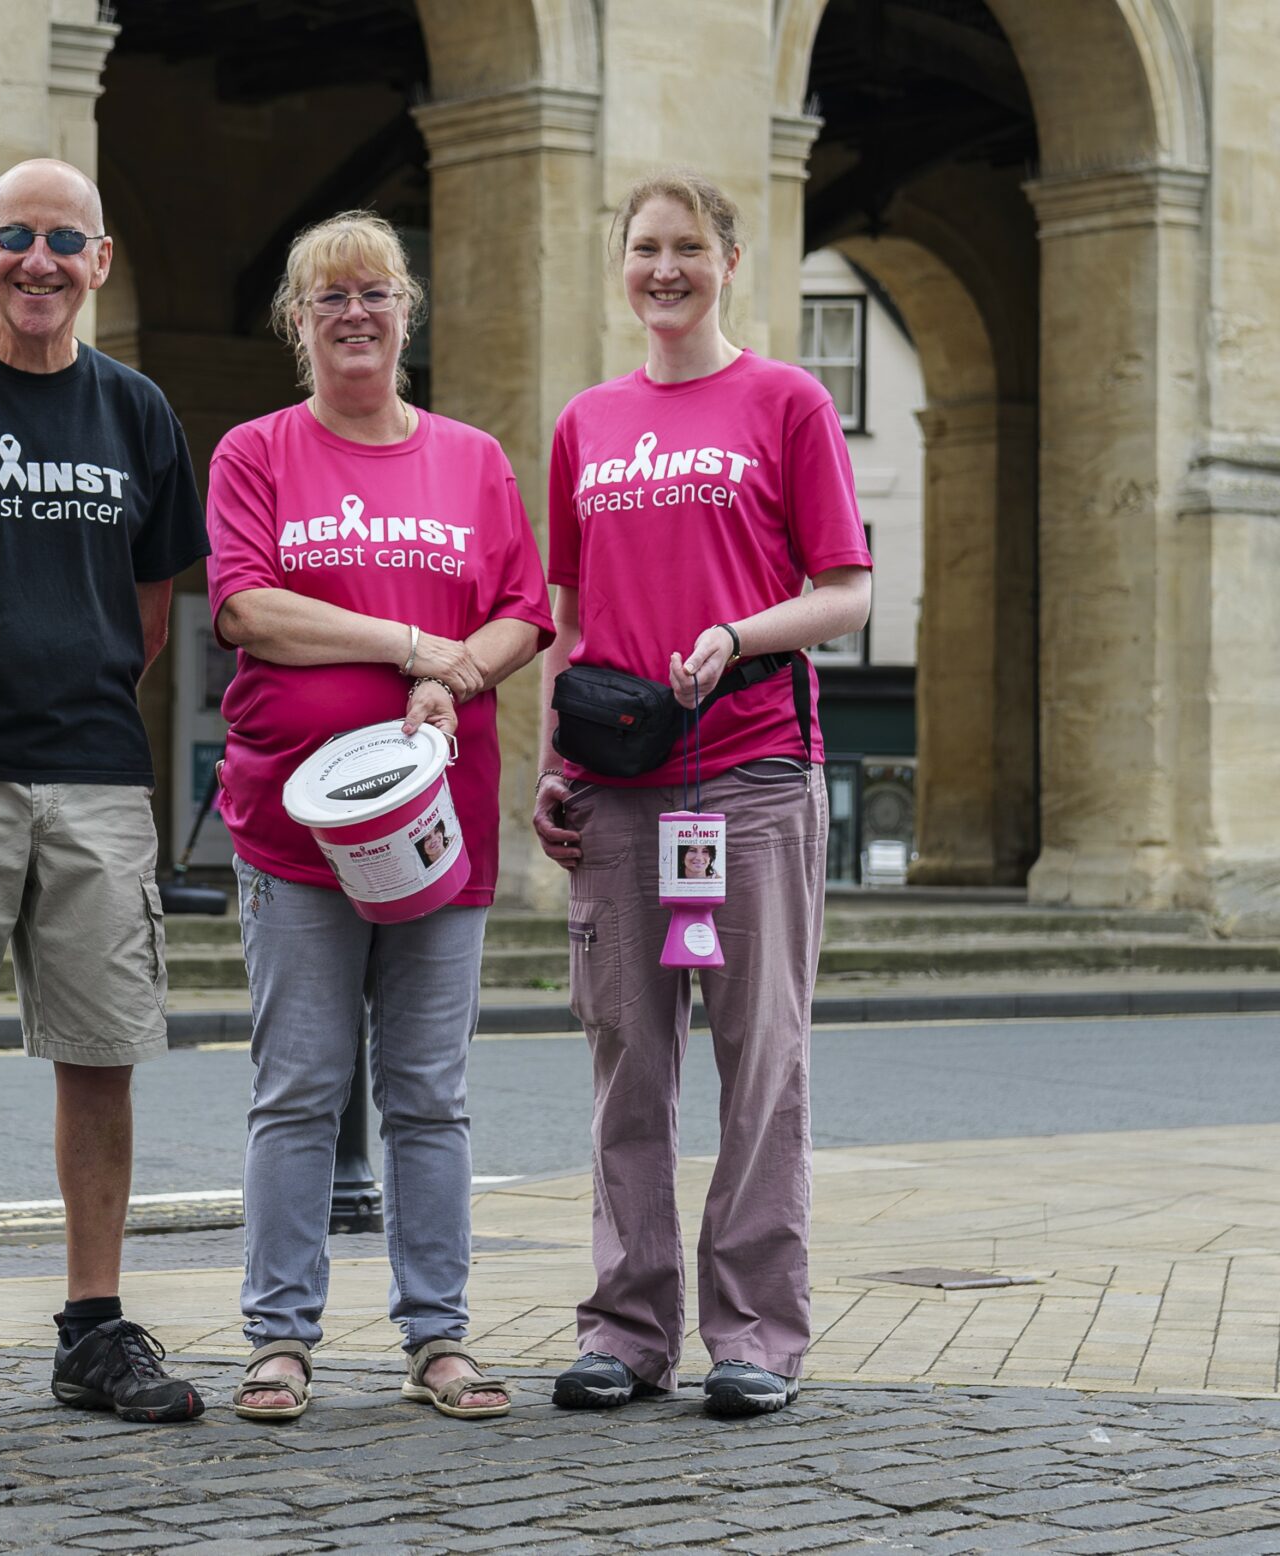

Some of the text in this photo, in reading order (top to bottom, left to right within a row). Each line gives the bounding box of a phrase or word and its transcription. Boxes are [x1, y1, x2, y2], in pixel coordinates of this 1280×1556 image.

[578, 431, 751, 494] AGAINST
[31, 500, 123, 525] cancer
[579, 484, 738, 520] breast cancer
[278, 494, 471, 553] AGAINST
[280, 544, 466, 577] breast cancer
[320, 758, 343, 781] PLEASE
[344, 746, 366, 757] GIVE
[367, 738, 418, 750] GENEROUSLY
[343, 772, 401, 797] THANK YOU!
[678, 823, 719, 838] AGAINST
[350, 844, 391, 858] AGAINST
